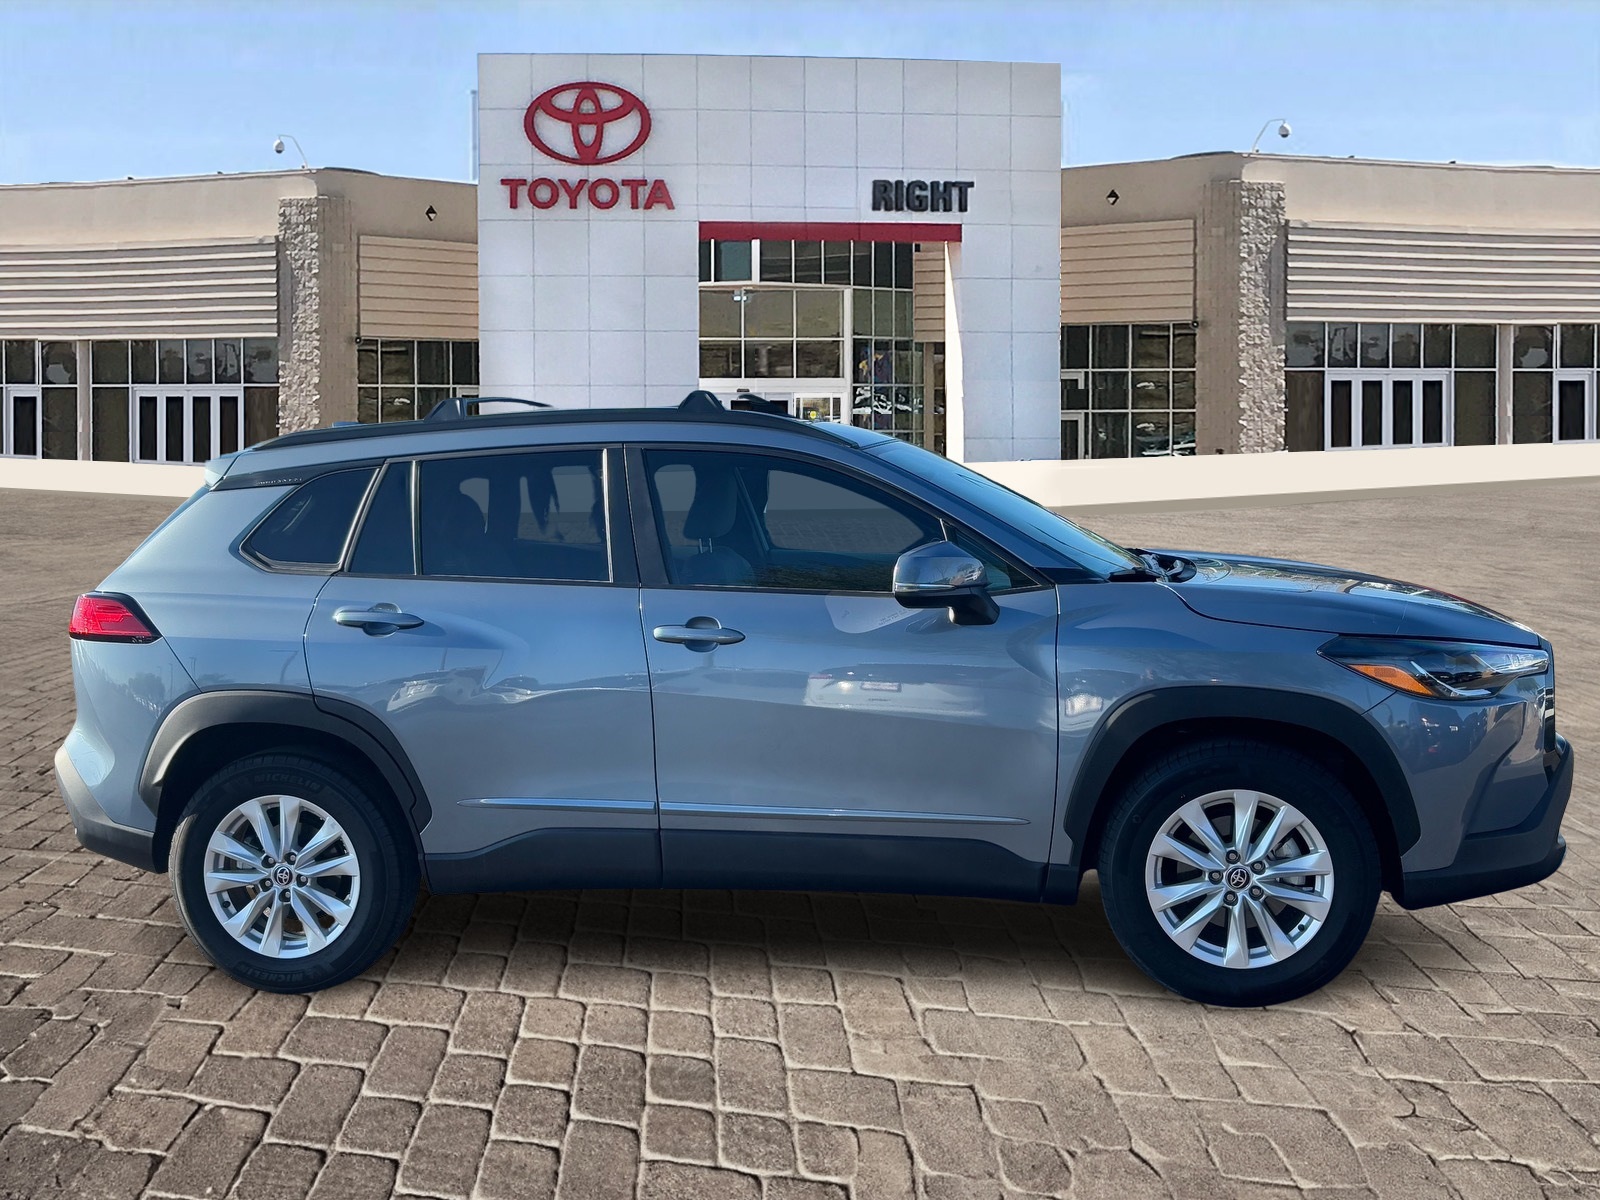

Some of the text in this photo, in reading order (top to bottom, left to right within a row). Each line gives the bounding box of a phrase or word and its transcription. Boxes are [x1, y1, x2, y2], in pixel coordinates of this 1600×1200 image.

[501, 178, 674, 210] TOYOTA
[871, 179, 975, 213] RIGHT
[254, 773, 321, 791] MICHELIN
